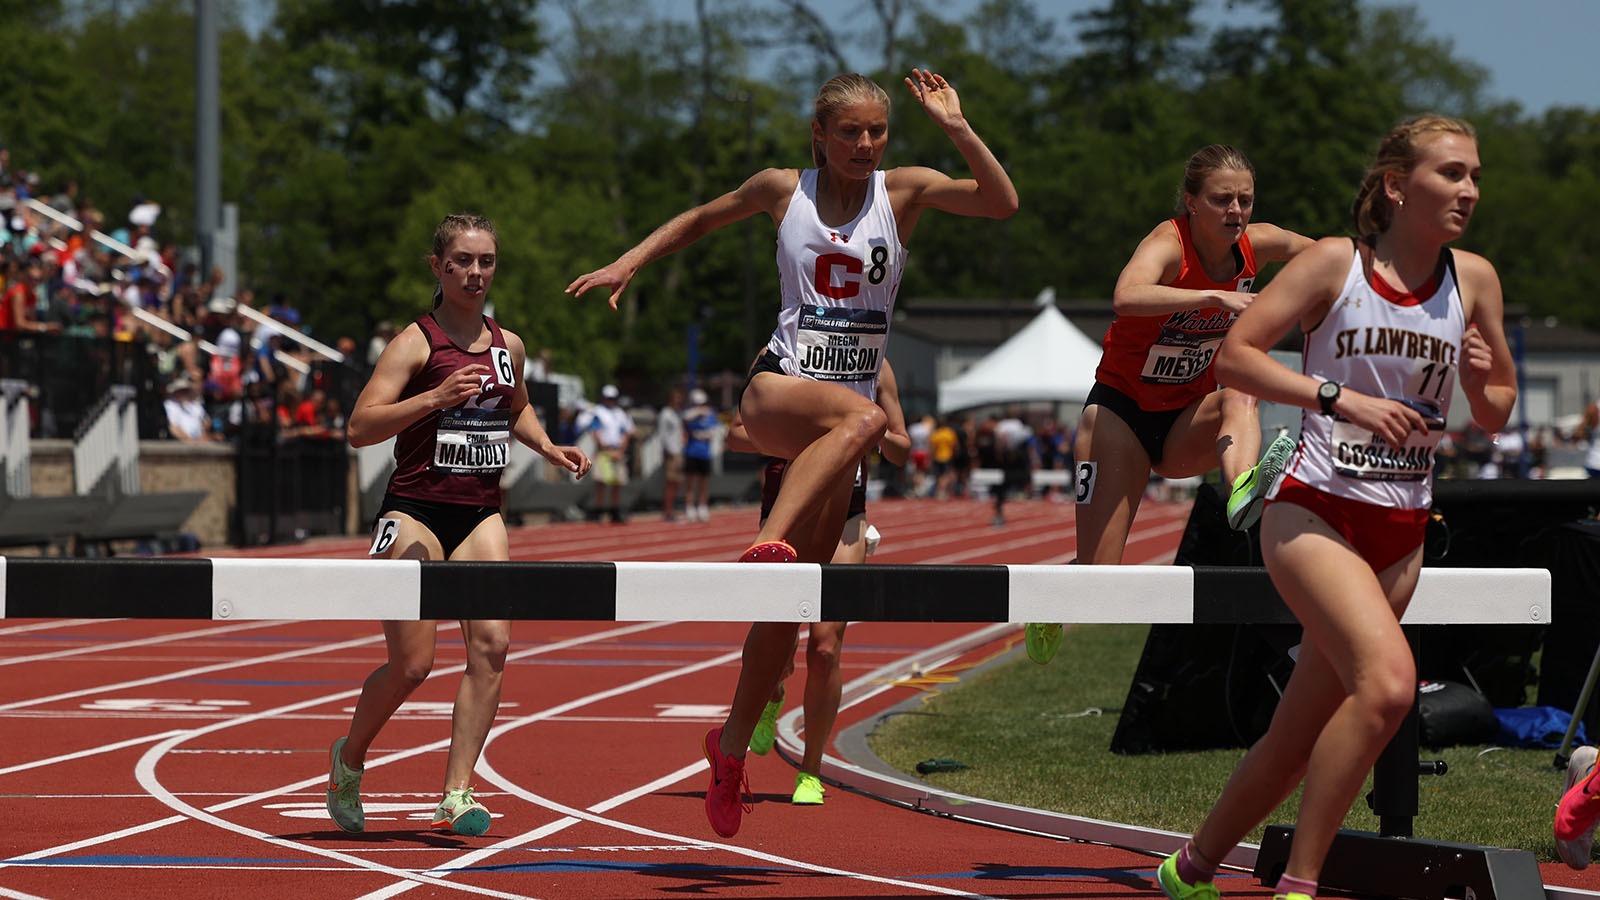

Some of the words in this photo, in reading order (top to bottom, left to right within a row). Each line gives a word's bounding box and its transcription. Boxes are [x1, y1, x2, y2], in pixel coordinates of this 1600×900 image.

[814, 252, 863, 300] C
[868, 246, 888, 285] 8
[814, 318, 831, 327] TRACK
[835, 320, 850, 328] FIELD
[828, 335, 860, 347] MEGAN
[1335, 328, 1360, 359] ST.
[1364, 327, 1456, 365] LAWRENCE
[498, 350, 511, 383] 6
[800, 346, 879, 372] JOHNSON
[1152, 348, 1214, 377] MEYER
[1418, 363, 1449, 399] 11
[466, 434, 489, 443] EMMA
[438, 443, 507, 466] MALOOLY
[1077, 463, 1092, 502] 3
[376, 520, 395, 552] 6
